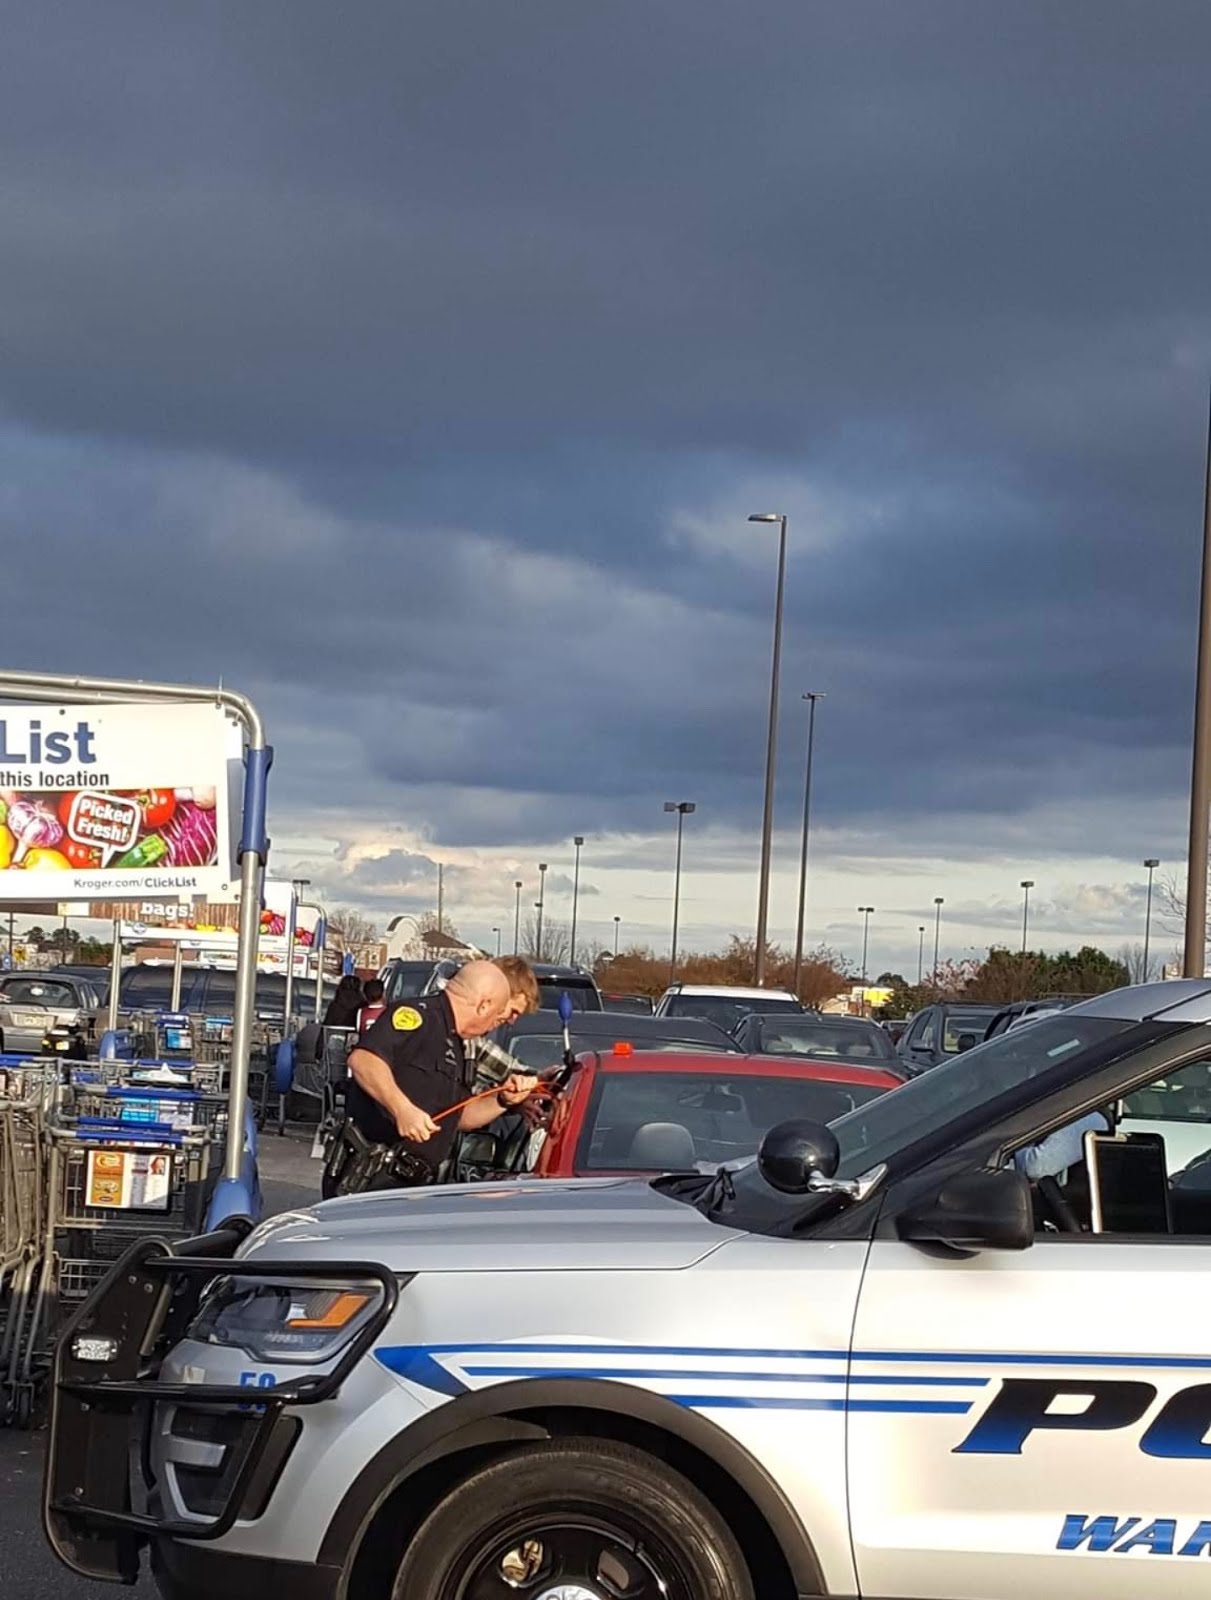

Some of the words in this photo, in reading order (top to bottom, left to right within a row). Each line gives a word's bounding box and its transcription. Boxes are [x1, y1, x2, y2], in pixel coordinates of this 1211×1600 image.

[0, 720, 97, 764] List
[0, 771, 33, 787] this
[39, 770, 110, 787] location
[79, 799, 134, 826] Picked
[77, 816, 128, 843] Fresh!
[74, 877, 197, 890] Kroger.com/ClickList
[140, 902, 194, 920] bags!
